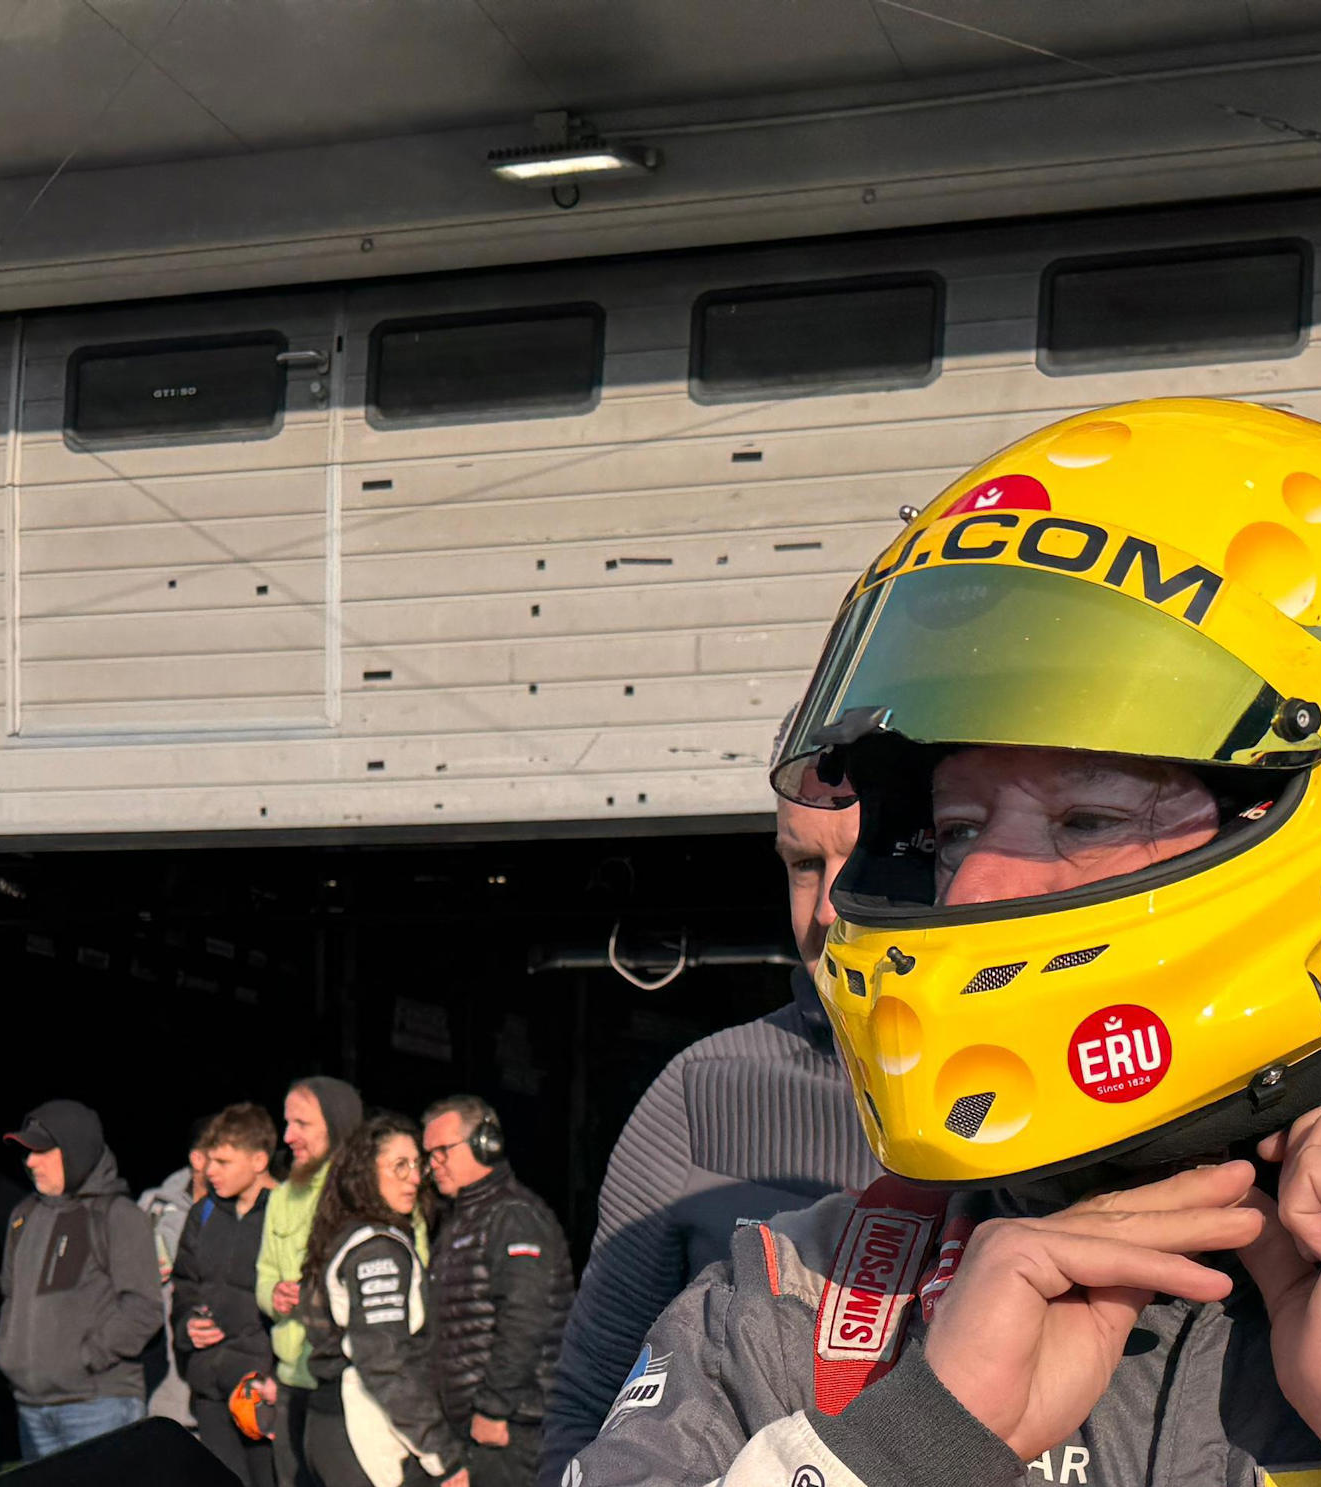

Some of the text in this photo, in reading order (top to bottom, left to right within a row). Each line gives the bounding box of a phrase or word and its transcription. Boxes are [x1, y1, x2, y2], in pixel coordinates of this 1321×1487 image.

[1077, 1025, 1161, 1084] ERU
[1097, 1075, 1151, 1095] Since 1824
[839, 1222, 907, 1344] SIMPSON
